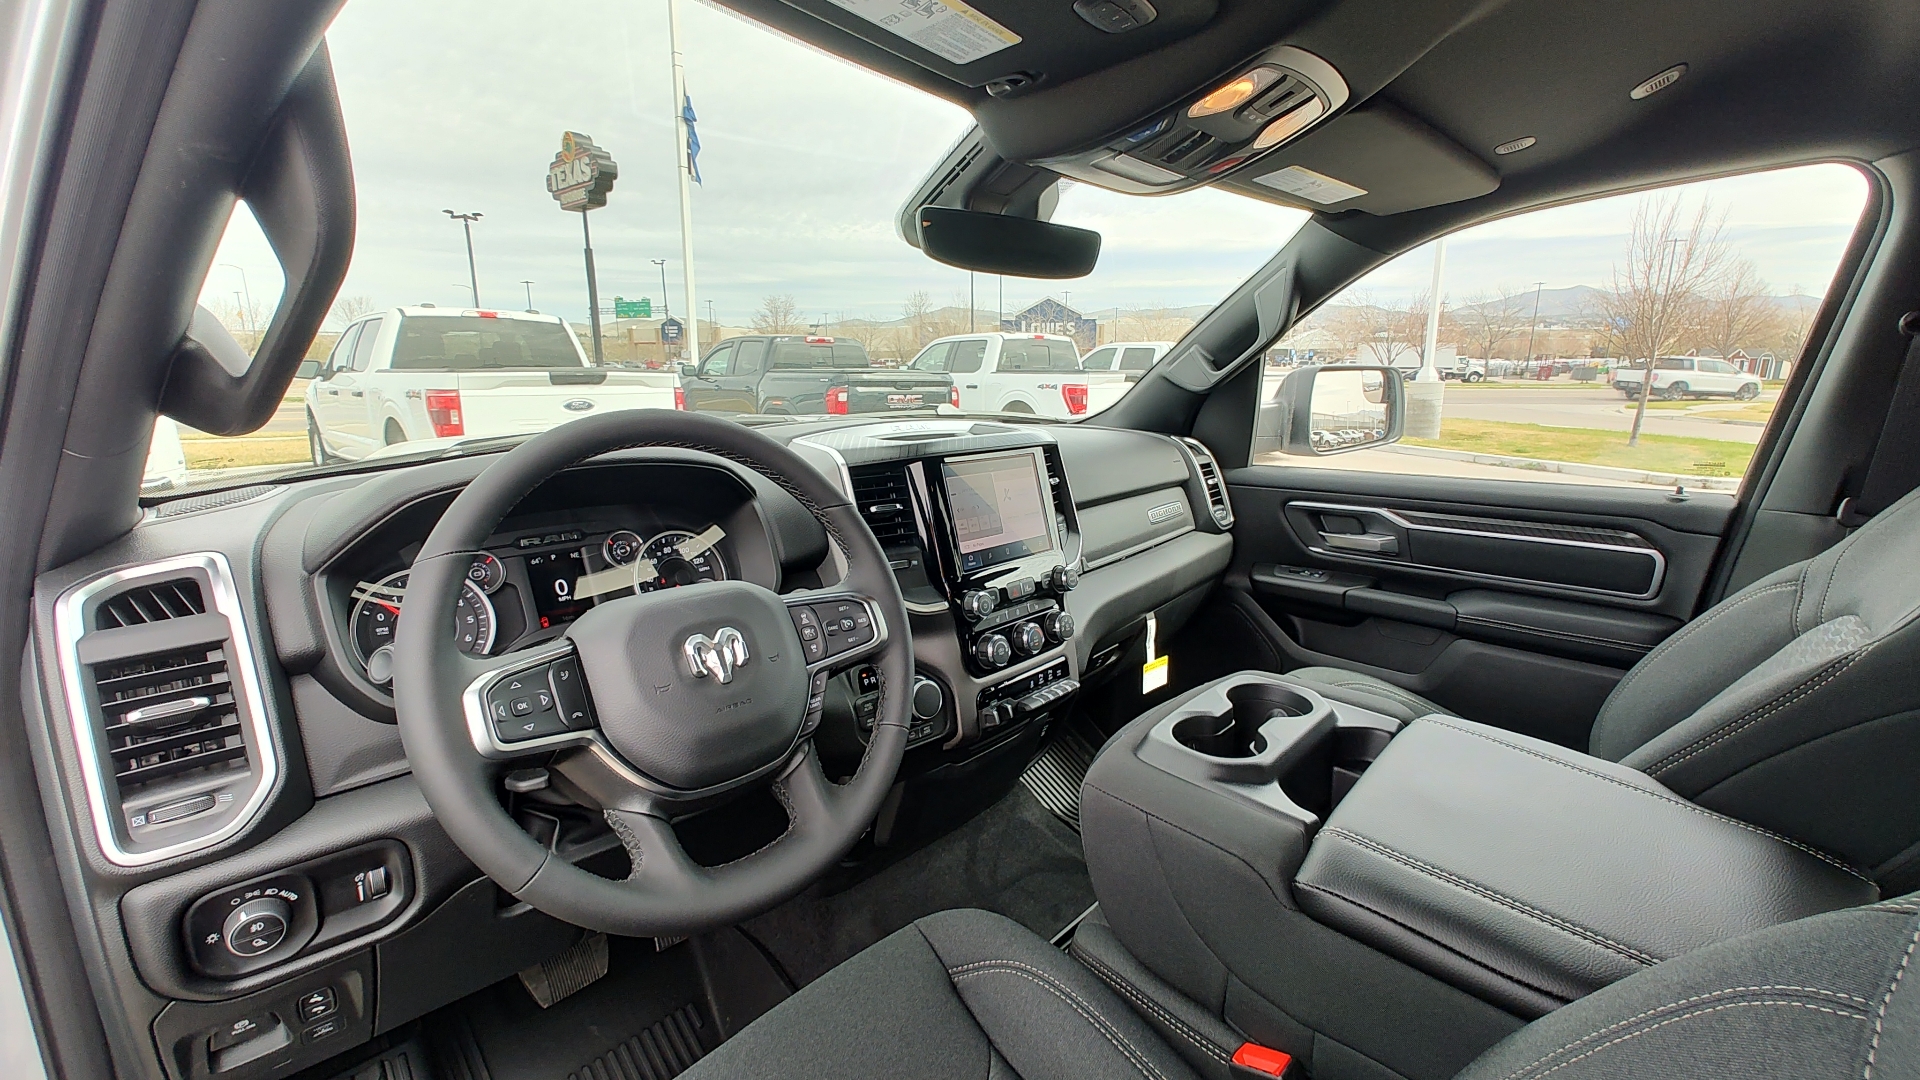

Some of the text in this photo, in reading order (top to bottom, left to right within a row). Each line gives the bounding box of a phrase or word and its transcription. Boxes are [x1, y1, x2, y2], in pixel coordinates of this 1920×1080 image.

[550, 156, 592, 192] TEXAS
[887, 394, 923, 404] GMC
[520, 534, 582, 547] RAM
[663, 546, 672, 554] 80
[692, 557, 704, 565] 120
[554, 579, 569, 596] 0
[376, 613, 385, 621] 0
[466, 615, 475, 624] 5
[464, 634, 472, 642] 6
[516, 702, 528, 710] OK
[715, 698, 752, 714] AIRBAG
[278, 889, 298, 901] AUTO
